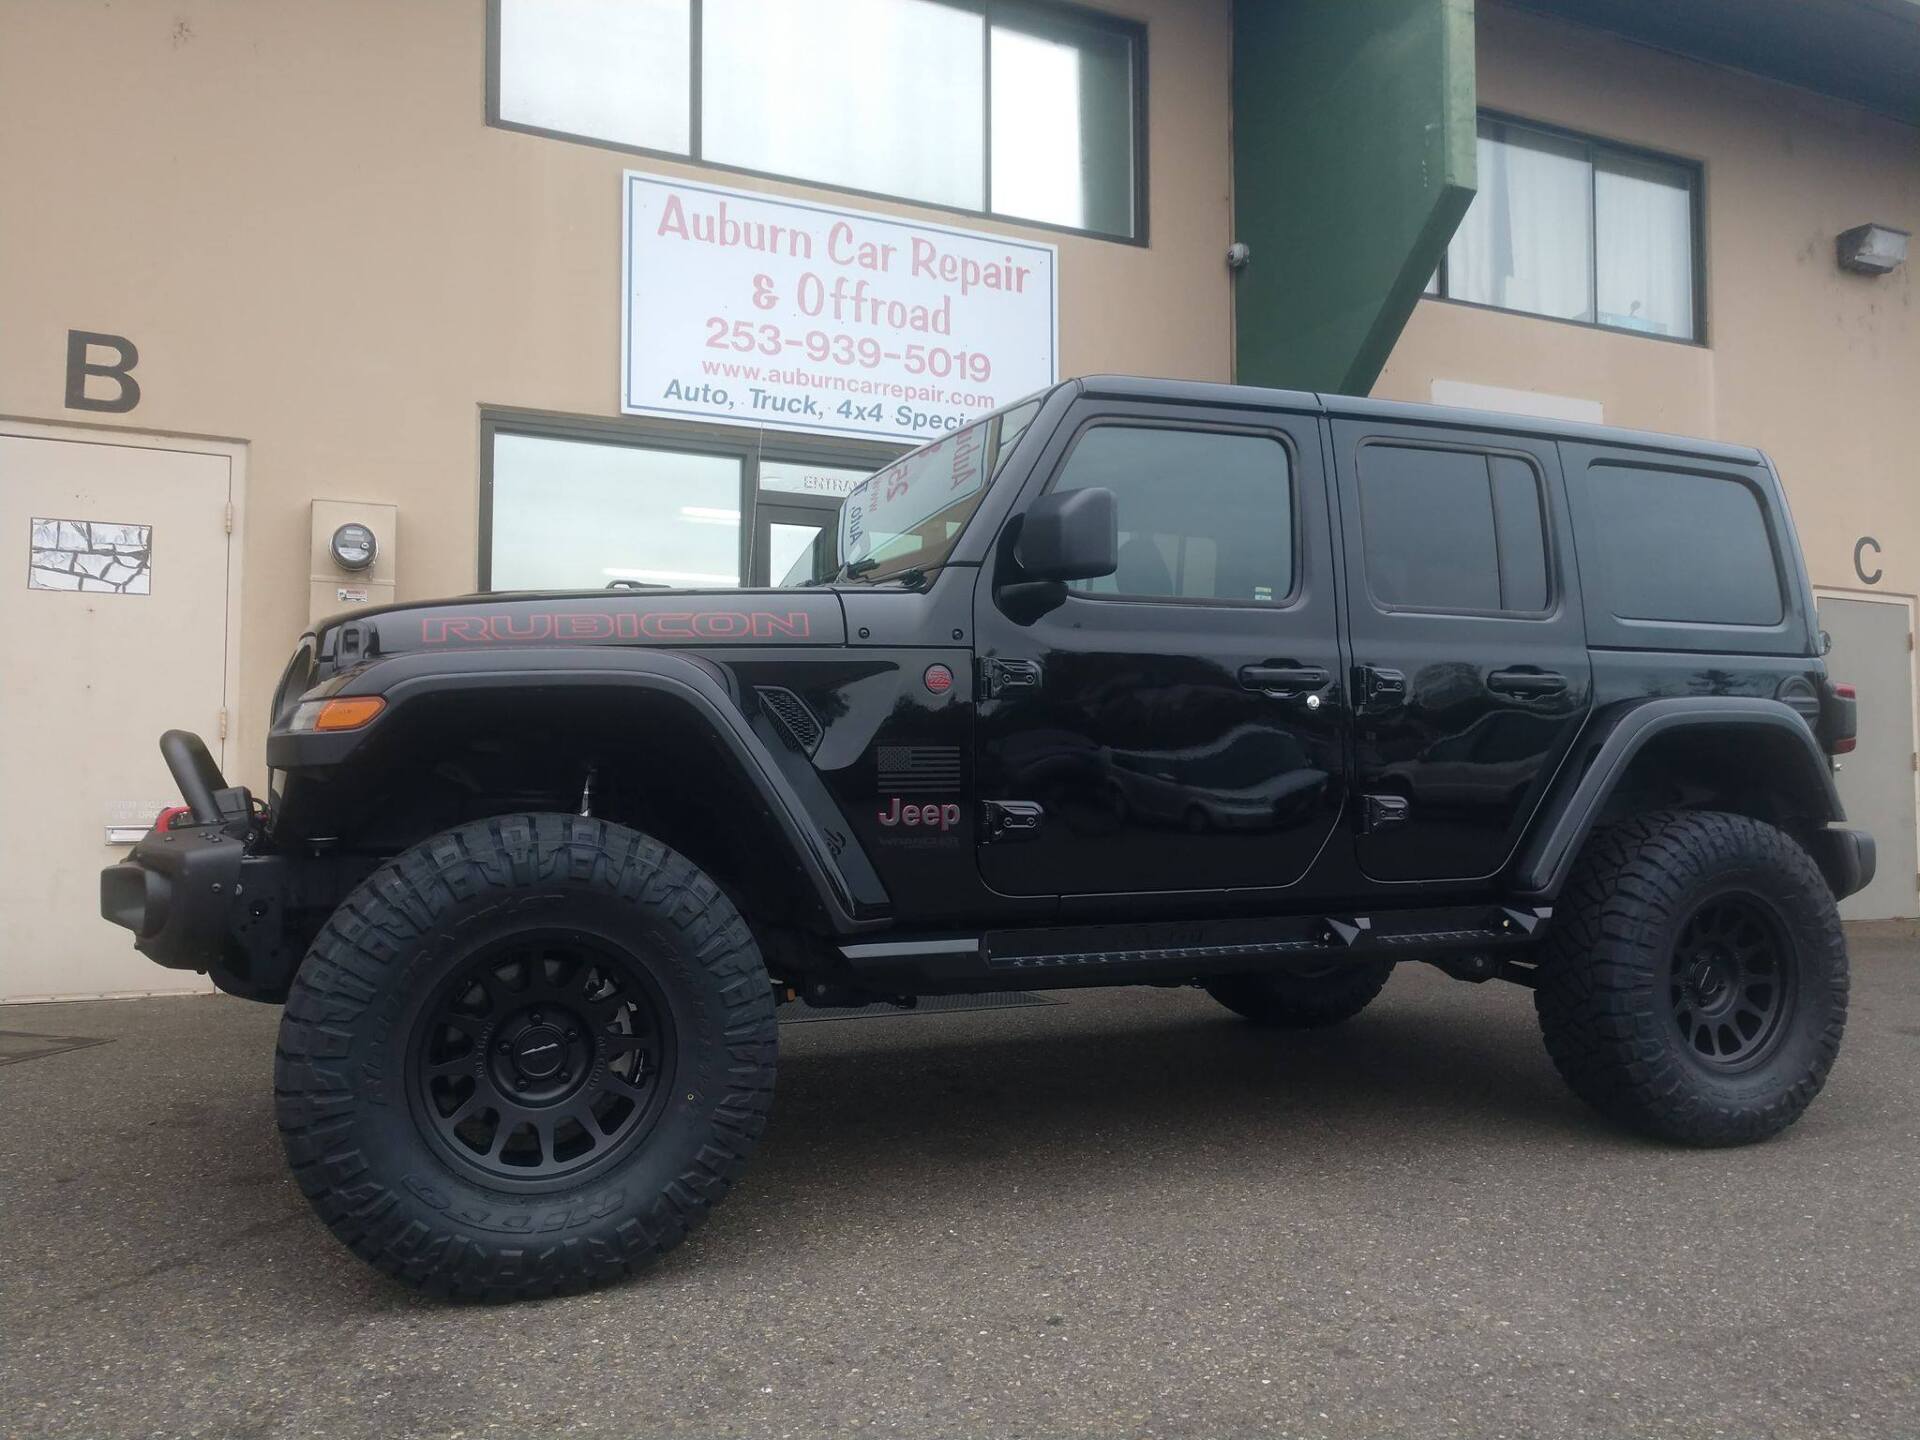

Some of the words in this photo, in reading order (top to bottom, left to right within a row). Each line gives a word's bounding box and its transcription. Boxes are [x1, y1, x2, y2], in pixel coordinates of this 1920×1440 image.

[657, 194, 812, 260] Auburn
[828, 221, 897, 272] Car
[911, 236, 1031, 296] Repair
[752, 273, 780, 310] &
[797, 272, 951, 336] Offroad
[65, 329, 141, 413] B
[705, 316, 992, 383] 253-939-5019
[663, 378, 735, 410] Auto,
[750, 388, 824, 420] Truck,
[836, 399, 883, 423] 4x4
[701, 359, 995, 409] www.auburncarrepair.com
[1854, 536, 1882, 585] C
[421, 612, 810, 643] RUBICON
[877, 798, 960, 831] Jeep
